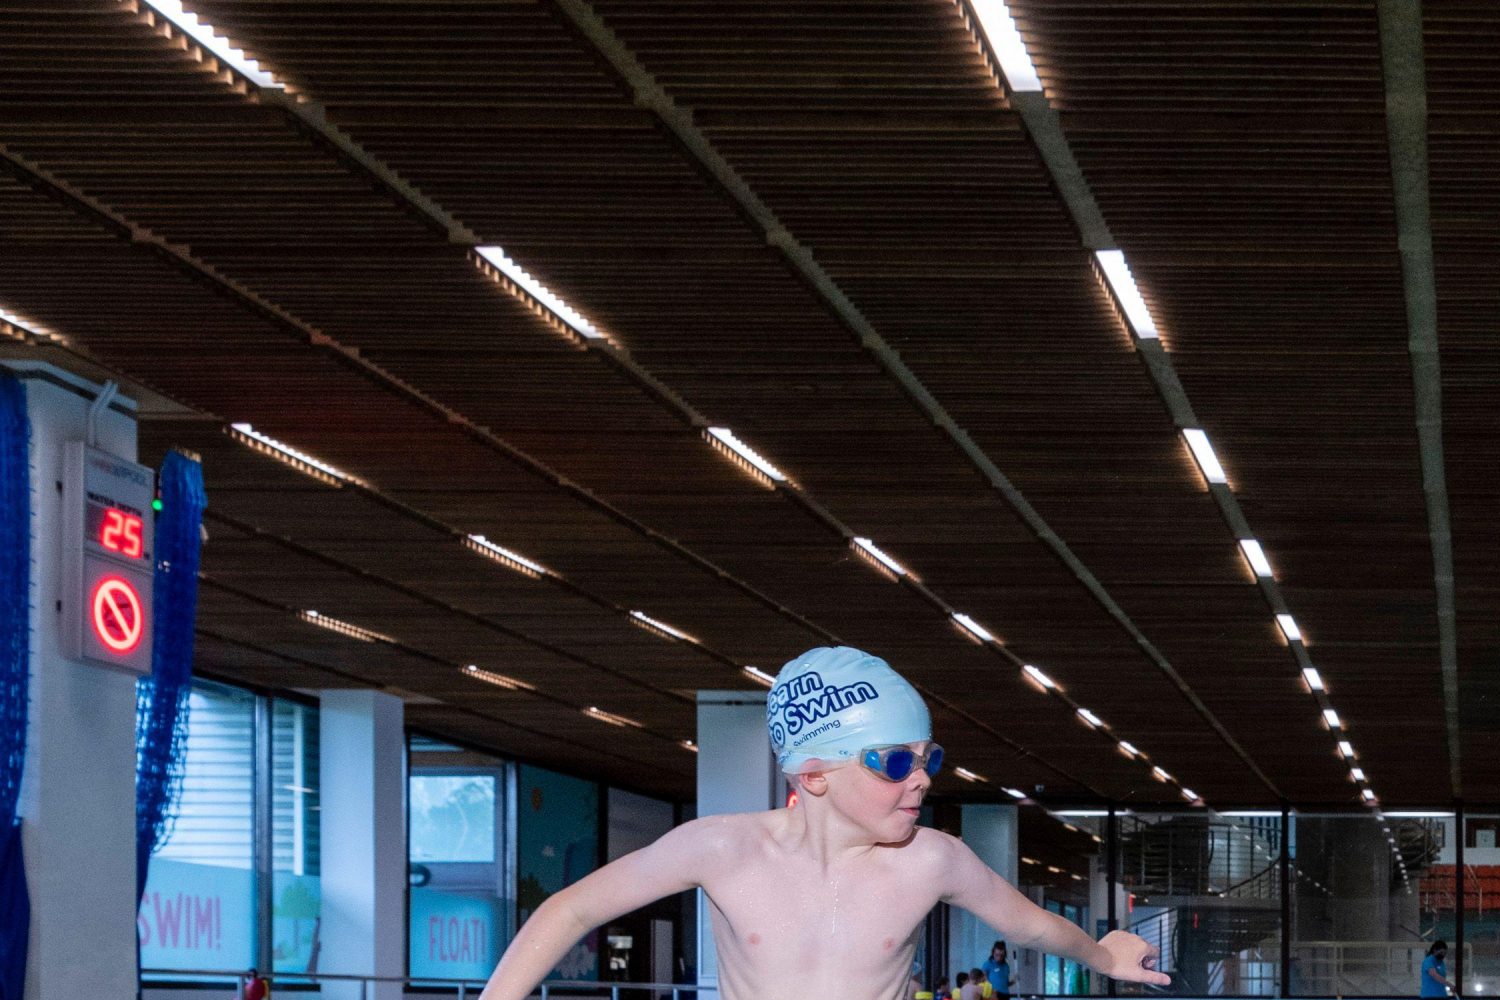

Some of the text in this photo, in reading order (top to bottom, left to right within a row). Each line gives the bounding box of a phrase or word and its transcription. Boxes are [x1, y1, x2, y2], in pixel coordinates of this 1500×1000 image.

[102, 508, 143, 557] 25
[768, 671, 824, 717] earn
[784, 681, 878, 735] Swim
[793, 719, 841, 747] swimming
[139, 892, 222, 951] SWIM!
[428, 915, 487, 963] FLOAT!
